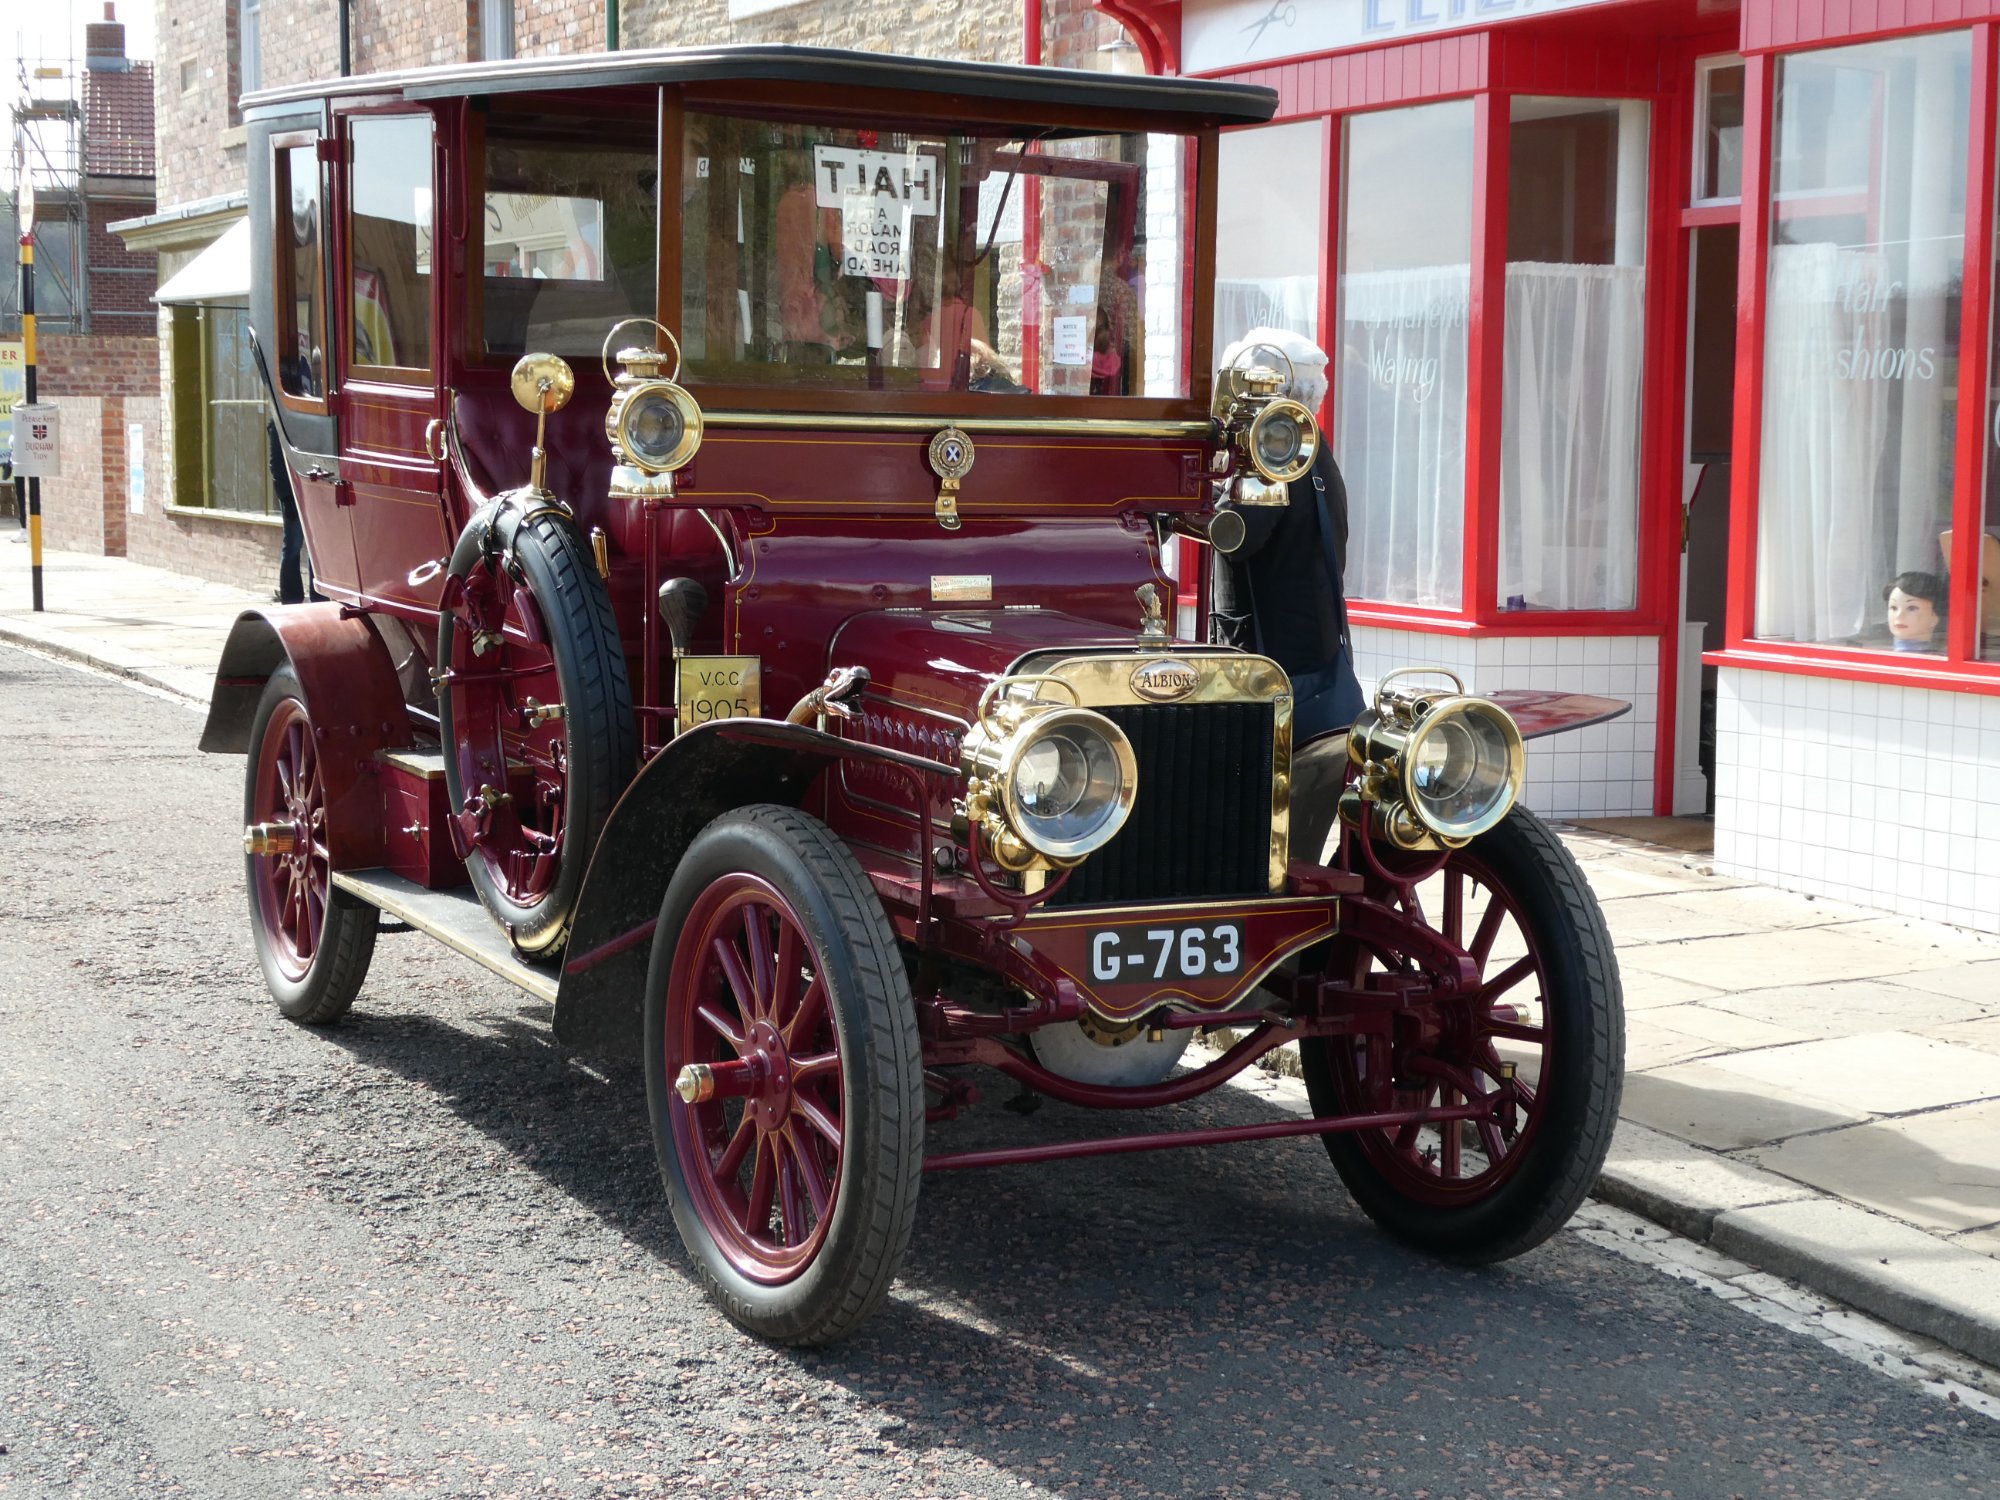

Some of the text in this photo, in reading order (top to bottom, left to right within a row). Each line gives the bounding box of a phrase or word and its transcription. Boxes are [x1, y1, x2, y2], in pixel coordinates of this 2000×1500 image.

[1370, 334, 1438, 403] Waving
[1820, 325, 1935, 381] shions
[25, 442, 54, 451] DURHAM
[1141, 672, 1190, 687] ALBION
[691, 699, 749, 723] 1905
[1093, 924, 1239, 980] G-763
